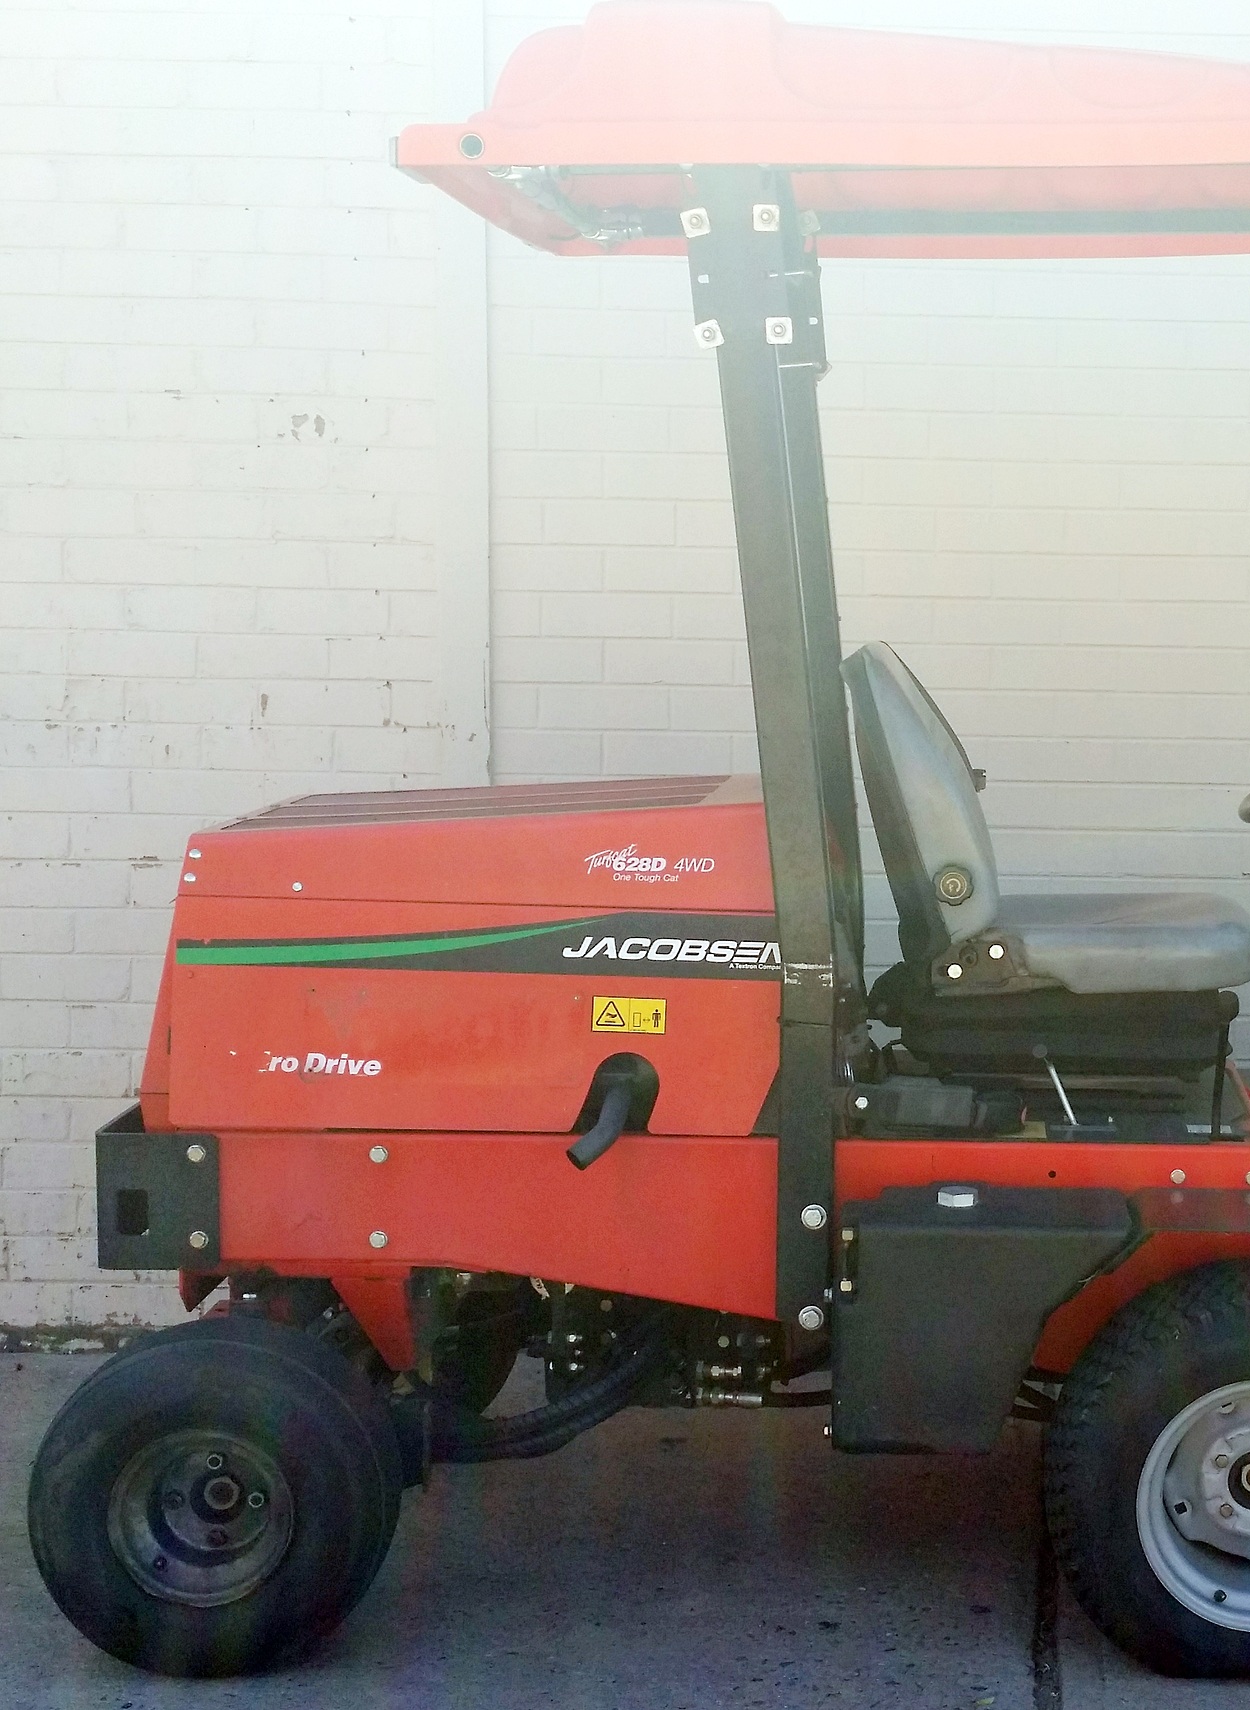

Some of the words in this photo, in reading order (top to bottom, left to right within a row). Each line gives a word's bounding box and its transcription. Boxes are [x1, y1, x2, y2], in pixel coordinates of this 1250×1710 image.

[584, 843, 638, 875] Turfcat
[612, 857, 666, 872] 628D
[673, 857, 715, 873] 4WD
[613, 873, 631, 881] One
[634, 873, 661, 883] Tough
[663, 874, 679, 882] Cat
[304, 1052, 382, 1076] Drive
